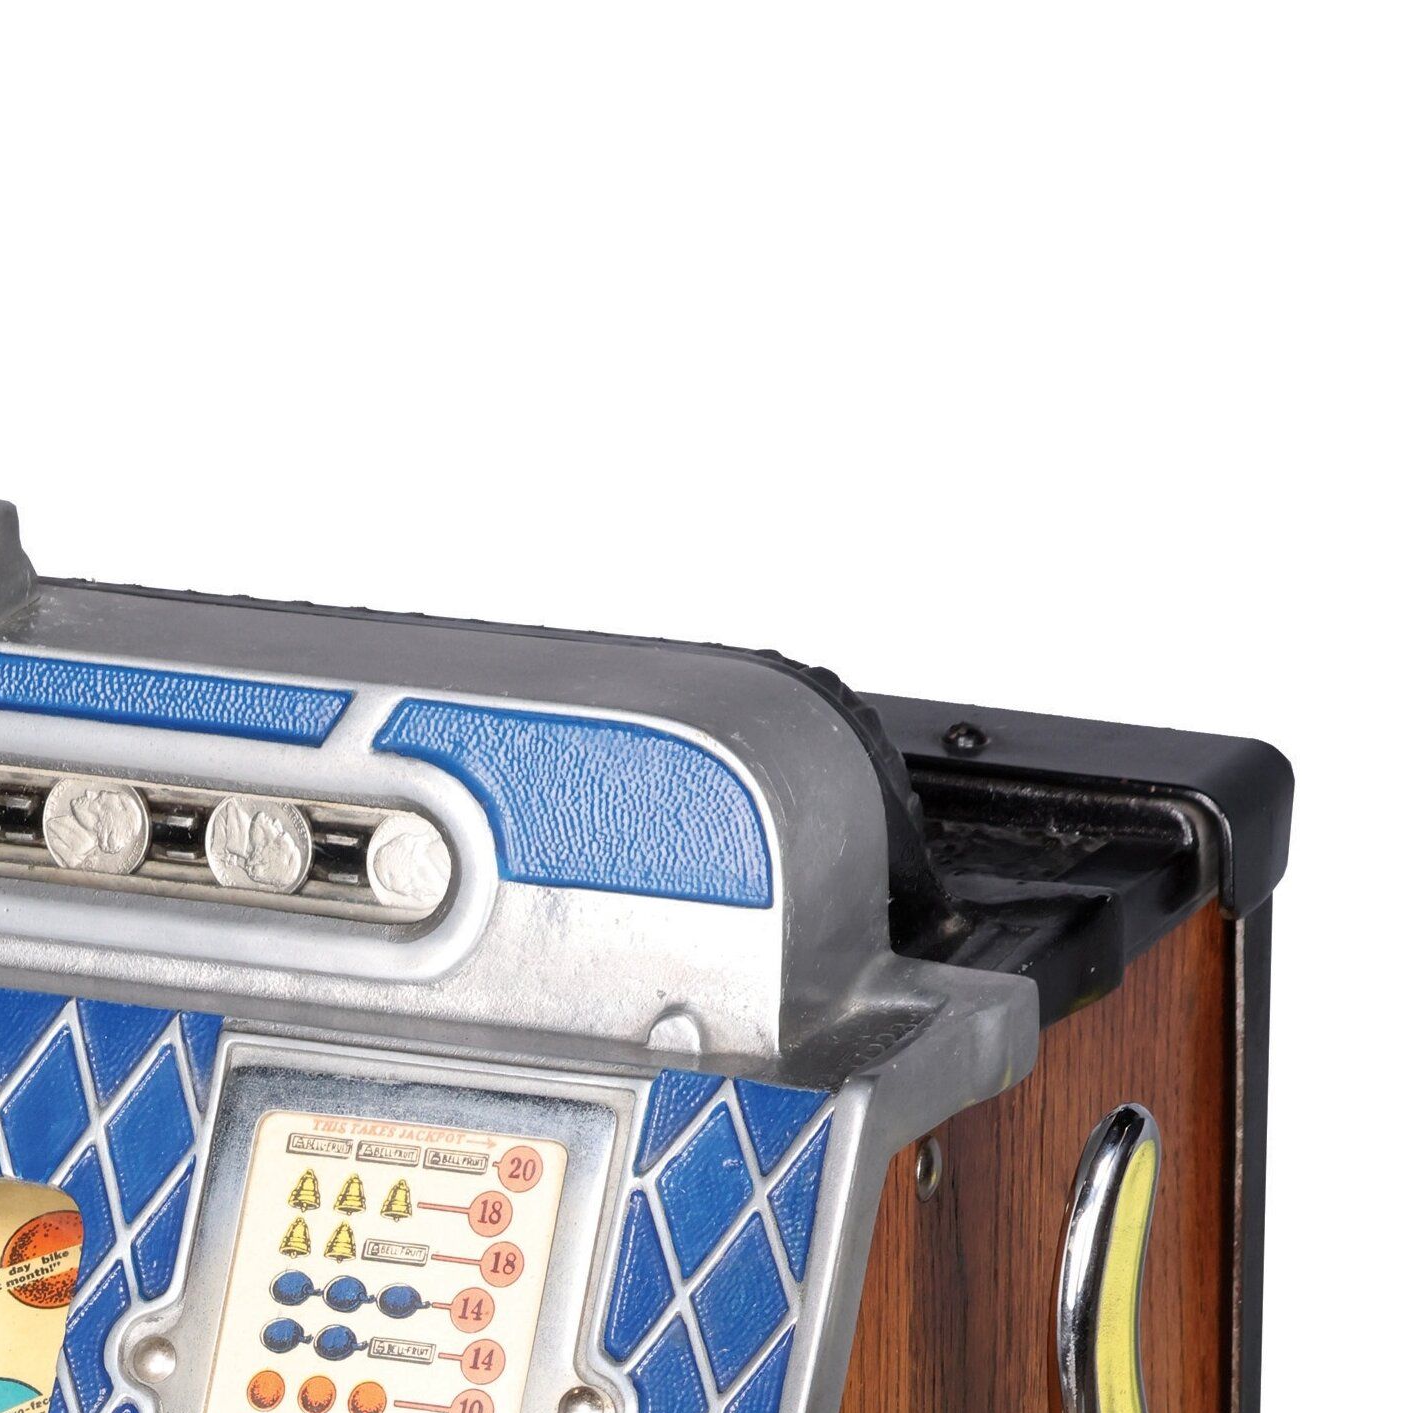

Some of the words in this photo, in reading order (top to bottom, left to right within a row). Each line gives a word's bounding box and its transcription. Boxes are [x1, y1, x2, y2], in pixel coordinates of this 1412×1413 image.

[312, 1118, 348, 1133] THIS
[351, 1122, 395, 1137] TAKES
[398, 1128, 466, 1144] JACKPOT
[508, 1157, 536, 1182] 20
[477, 1200, 503, 1225] 18
[9, 1263, 31, 1276] day
[41, 1250, 69, 1265] bike
[490, 1251, 517, 1275] 18
[459, 1297, 483, 1321] 14
[470, 1347, 494, 1371] 14
